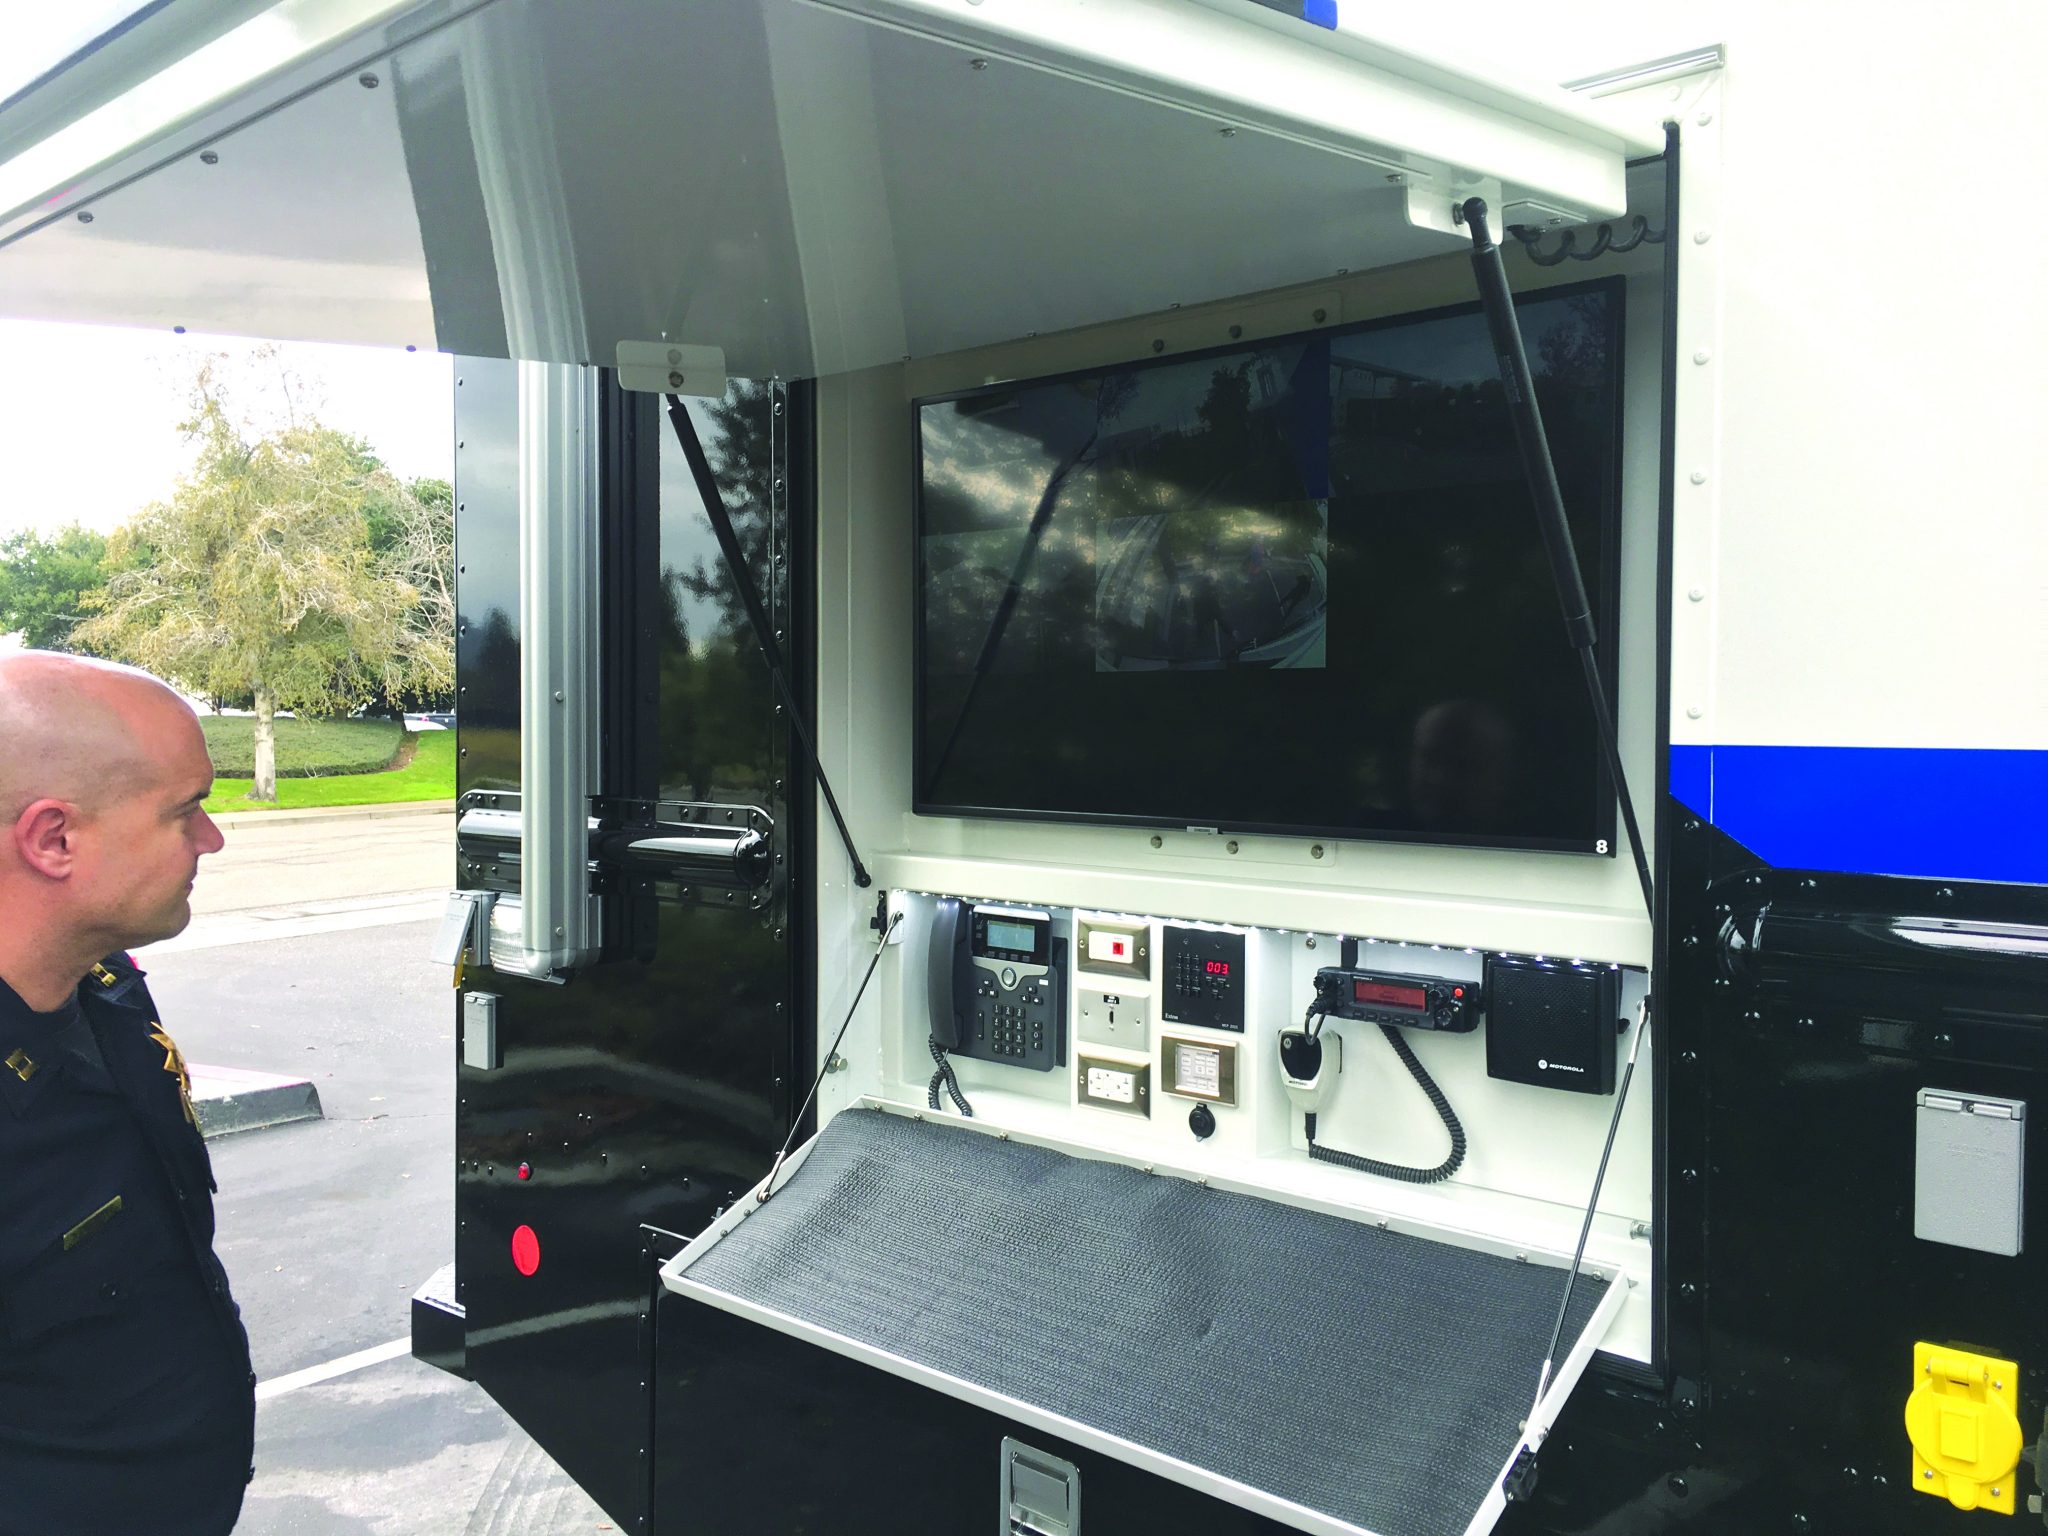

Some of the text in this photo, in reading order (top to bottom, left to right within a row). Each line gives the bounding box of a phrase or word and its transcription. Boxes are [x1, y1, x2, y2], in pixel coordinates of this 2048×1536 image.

[1596, 839, 1608, 854] 8
[1206, 961, 1229, 975] 003
[1548, 1063, 1584, 1073] MOTOROLA
